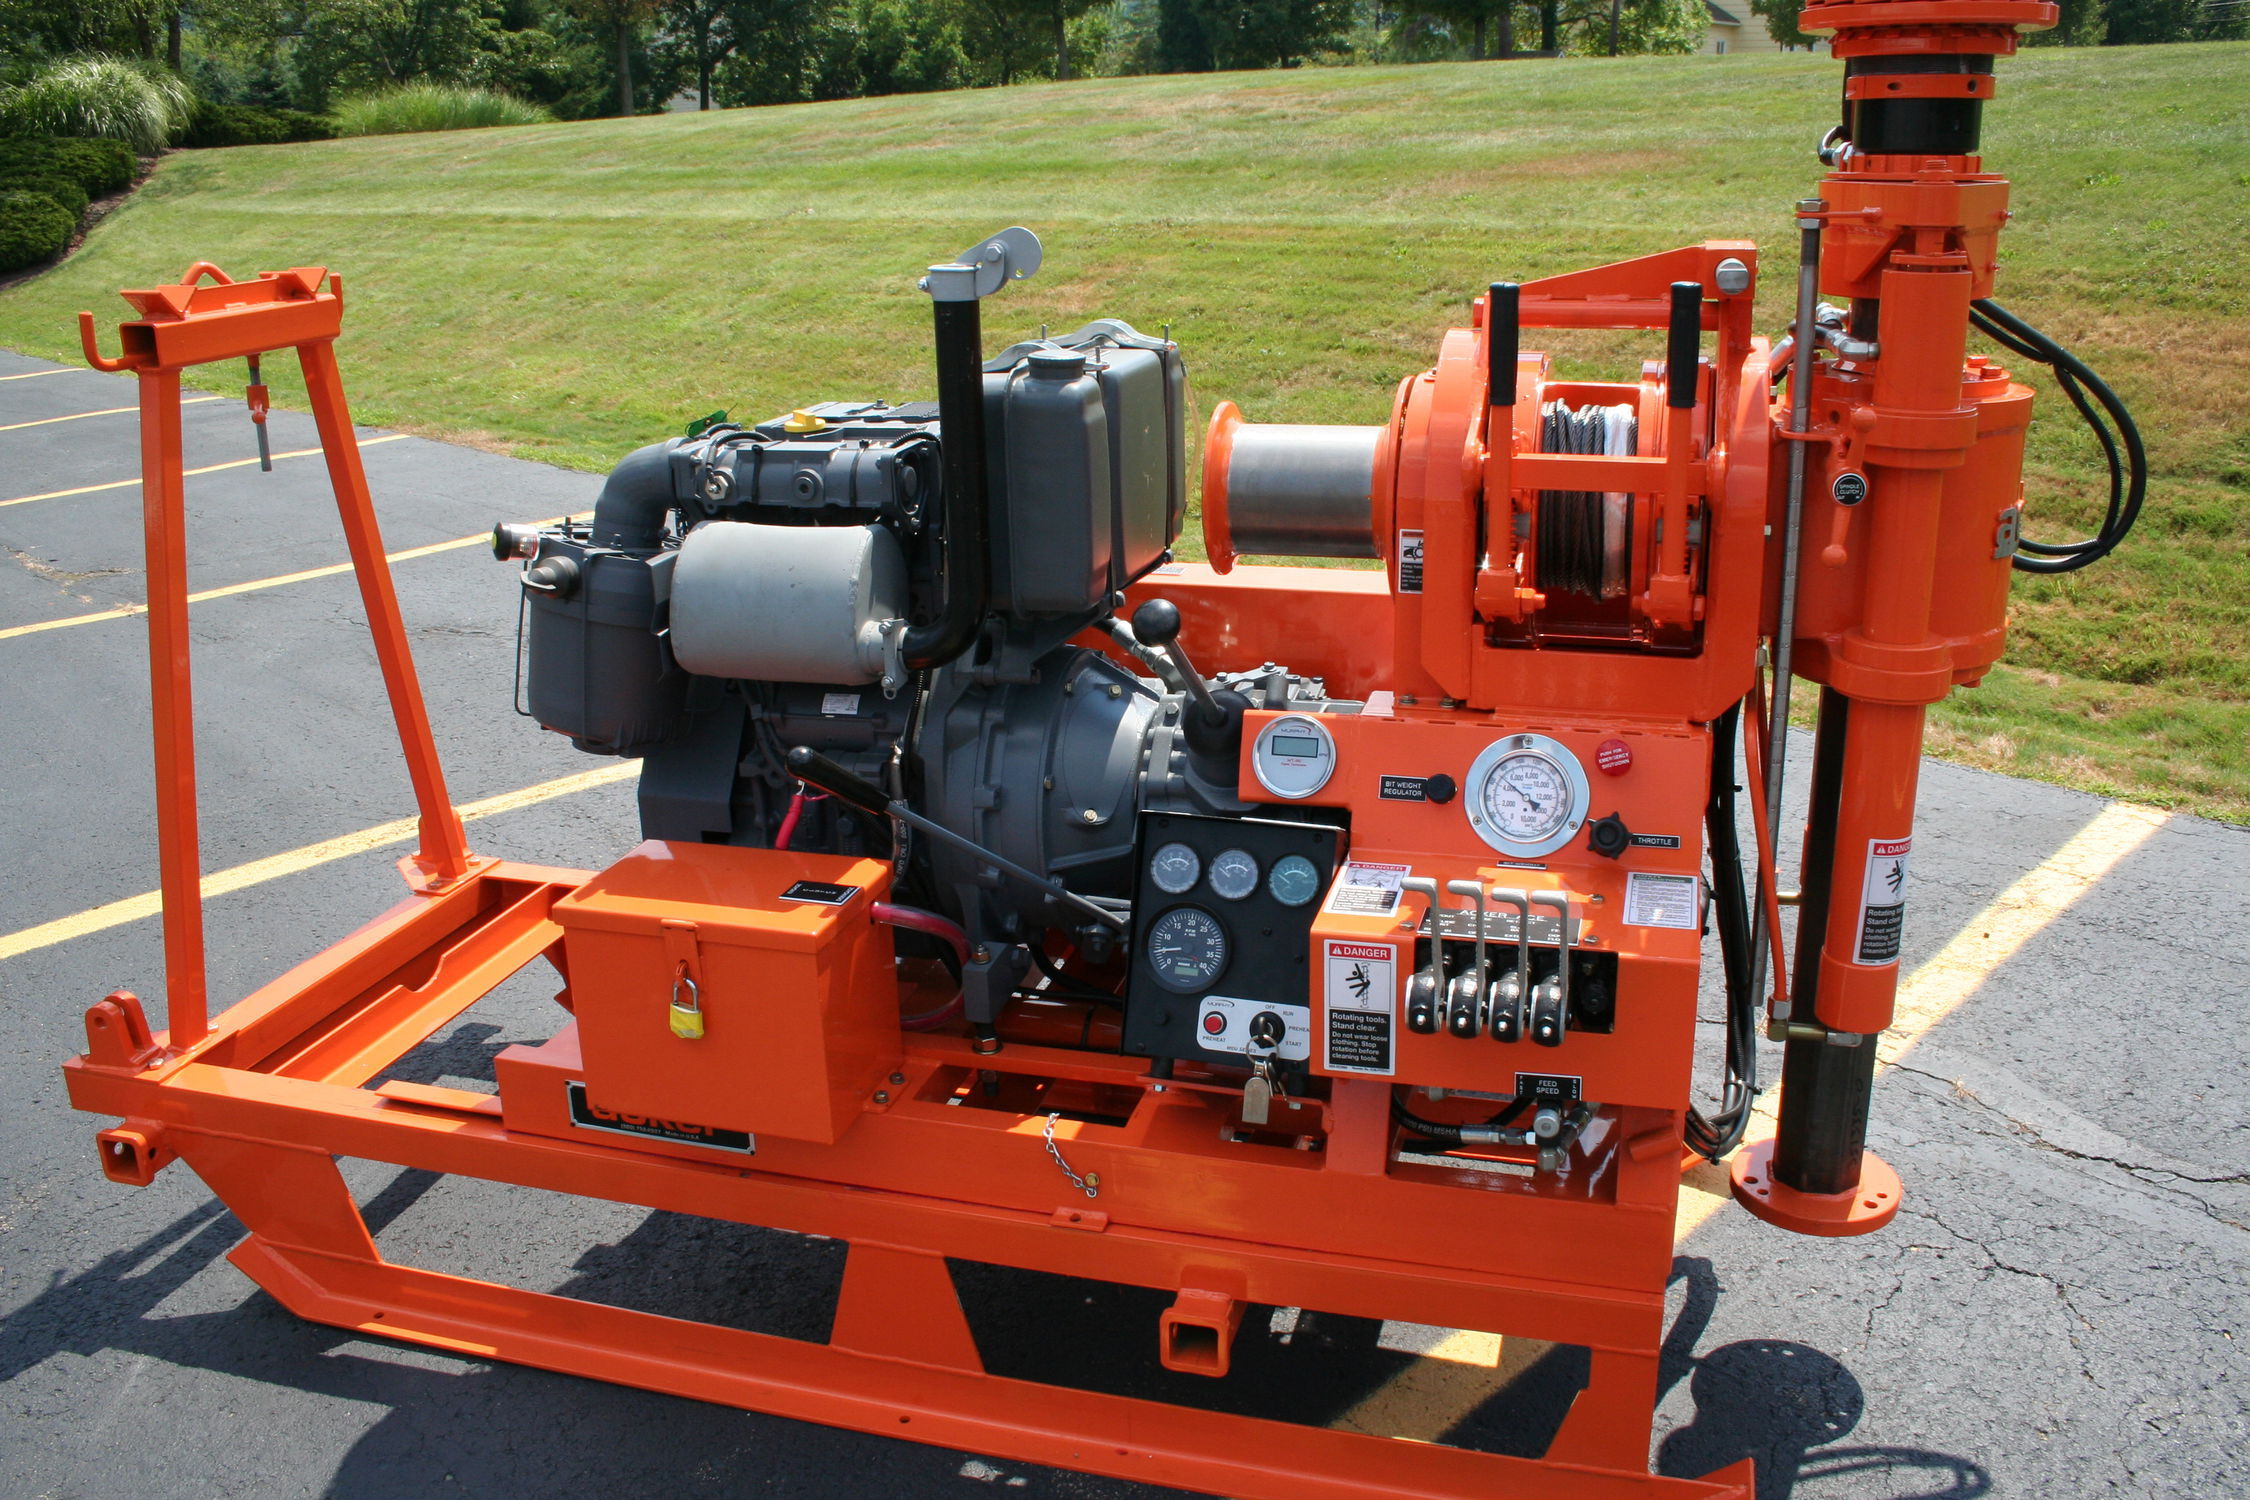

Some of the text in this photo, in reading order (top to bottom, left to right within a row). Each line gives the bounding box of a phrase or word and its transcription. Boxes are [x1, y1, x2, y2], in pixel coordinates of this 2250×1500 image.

[1384, 788, 1422, 797] REGULATOR
[1638, 837, 1672, 846] THROTTLE
[1867, 909, 1896, 917] Rotating
[1866, 917, 1888, 925] Stand
[1343, 946, 1388, 958] DANGER
[1332, 1012, 1387, 1024] Rotating tools.
[1332, 1021, 1377, 1031] Stand clear.
[1202, 1035, 1226, 1043] PREHEAT
[1332, 1038, 1377, 1048] clothing. Stop
[1332, 1053, 1359, 1061] cleaning
[1538, 1079, 1558, 1087] FEED
[1536, 1086, 1560, 1095] SPEED
